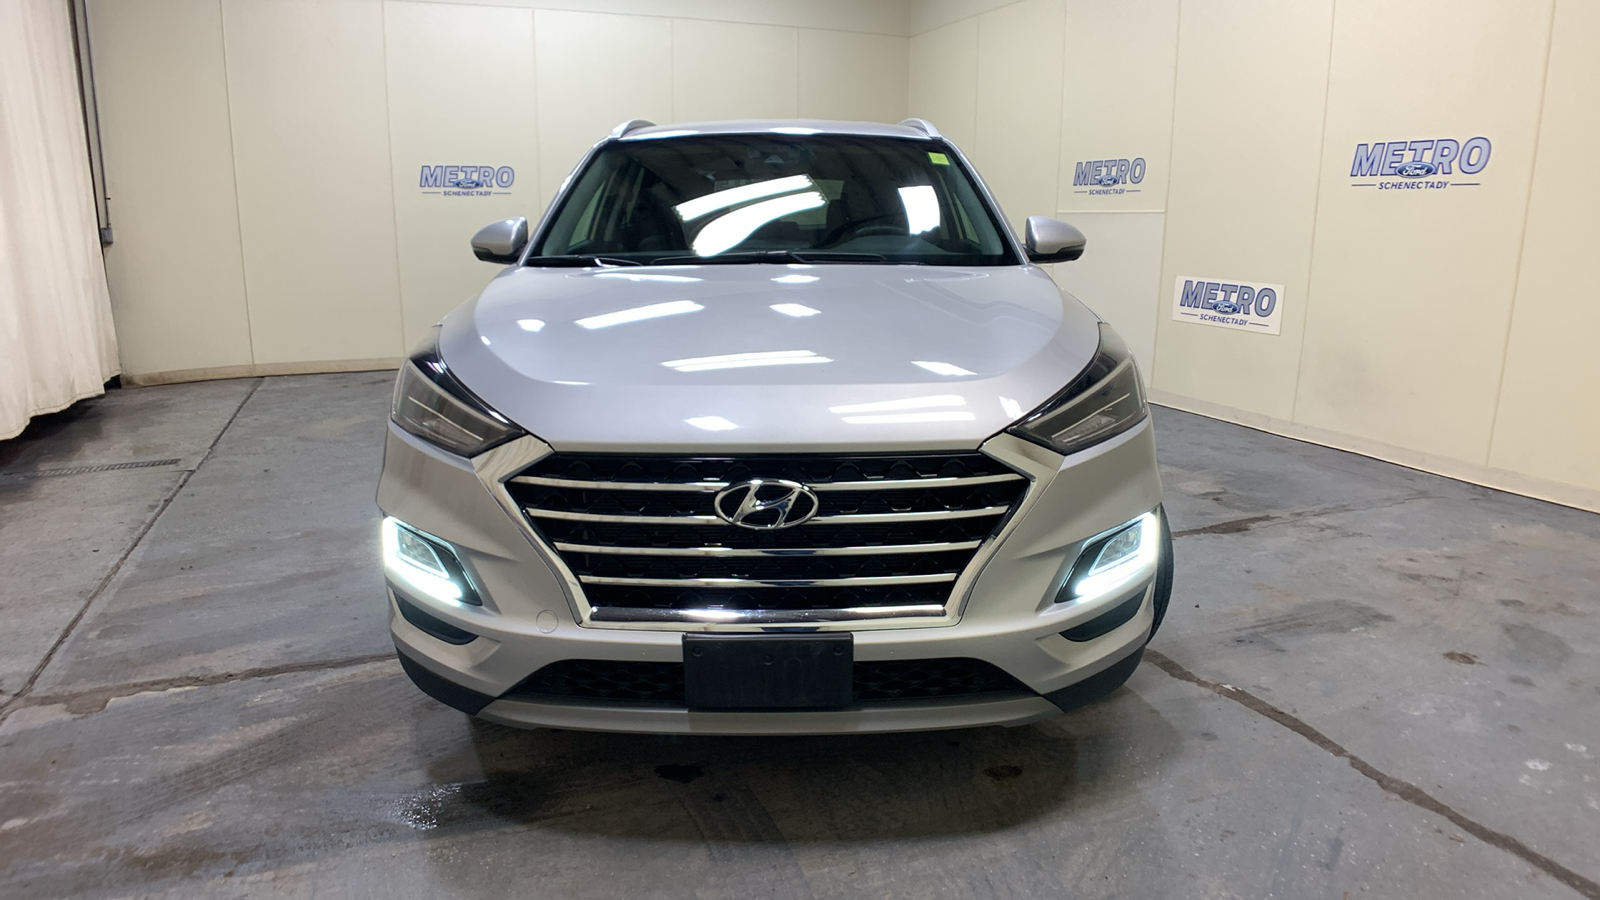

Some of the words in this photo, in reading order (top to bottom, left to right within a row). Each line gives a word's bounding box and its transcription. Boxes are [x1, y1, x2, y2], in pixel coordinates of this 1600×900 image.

[1350, 136, 1492, 177] METRO
[419, 165, 515, 188] METRO
[1073, 157, 1146, 186] METRO
[1378, 181, 1450, 190] SCHENECTADY
[1180, 280, 1277, 318] METRO
[1199, 313, 1249, 326] SCHENECTADY
